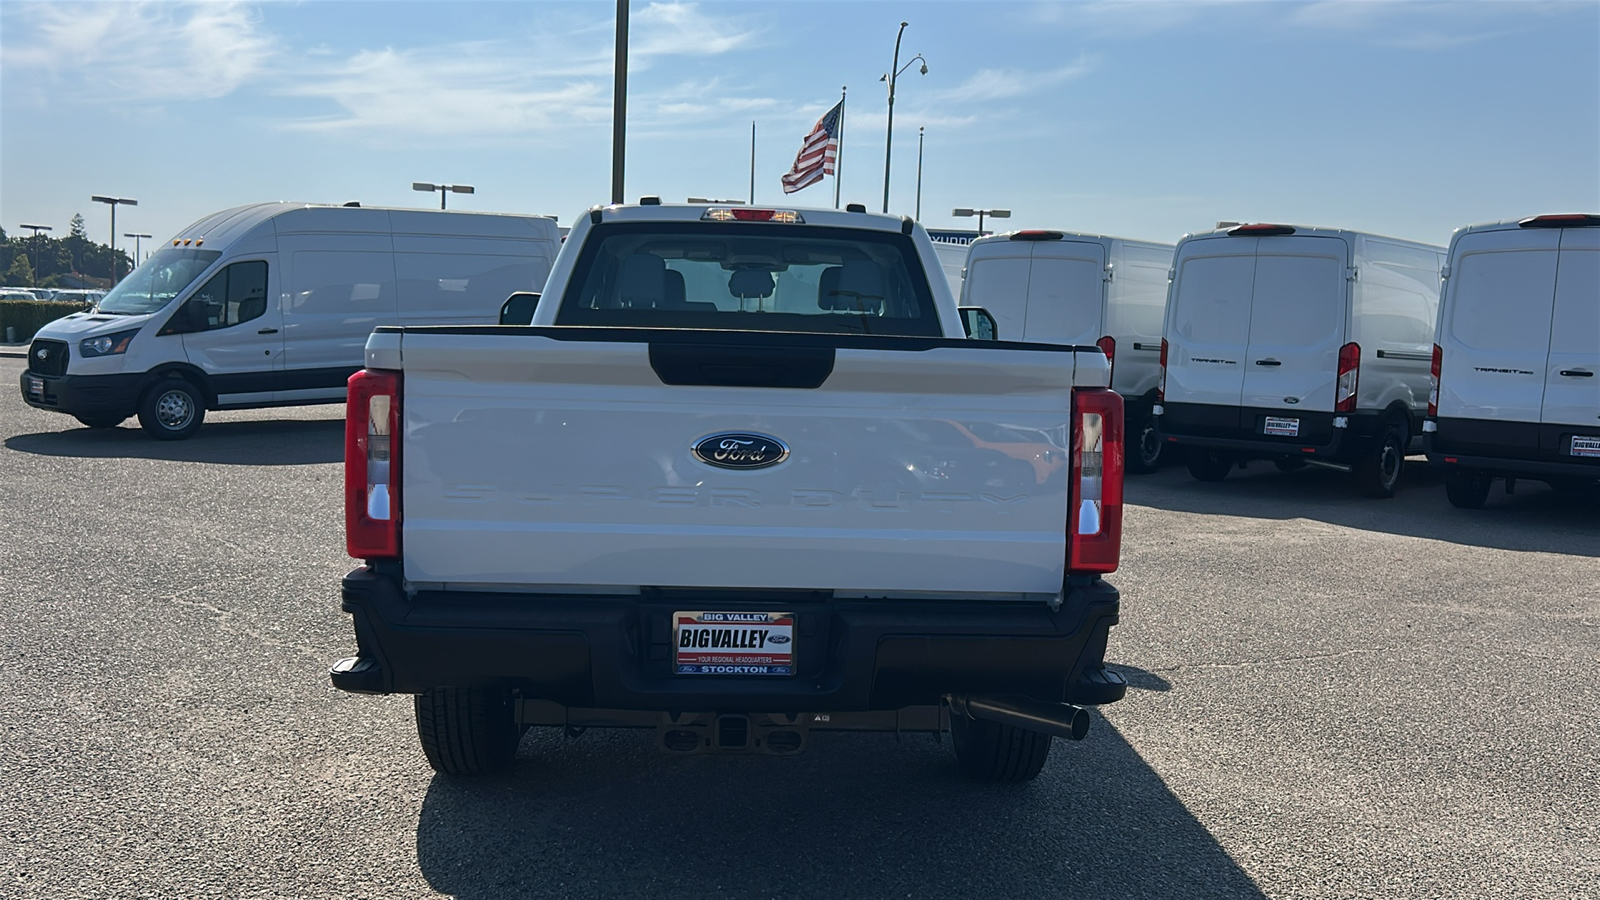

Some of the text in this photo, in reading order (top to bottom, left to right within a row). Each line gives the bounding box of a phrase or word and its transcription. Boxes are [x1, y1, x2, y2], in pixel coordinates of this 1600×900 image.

[930, 236, 974, 245] YUND
[714, 438, 767, 461] Ford
[442, 483, 1030, 514] SUPER DUTY
[703, 613, 768, 621] BIG VALLEY
[680, 629, 769, 648] BIGVALLEY
[712, 656, 735, 664] REGIONAL
[735, 656, 773, 664] HEADQUARTERS
[701, 665, 768, 674] STOCKTON
